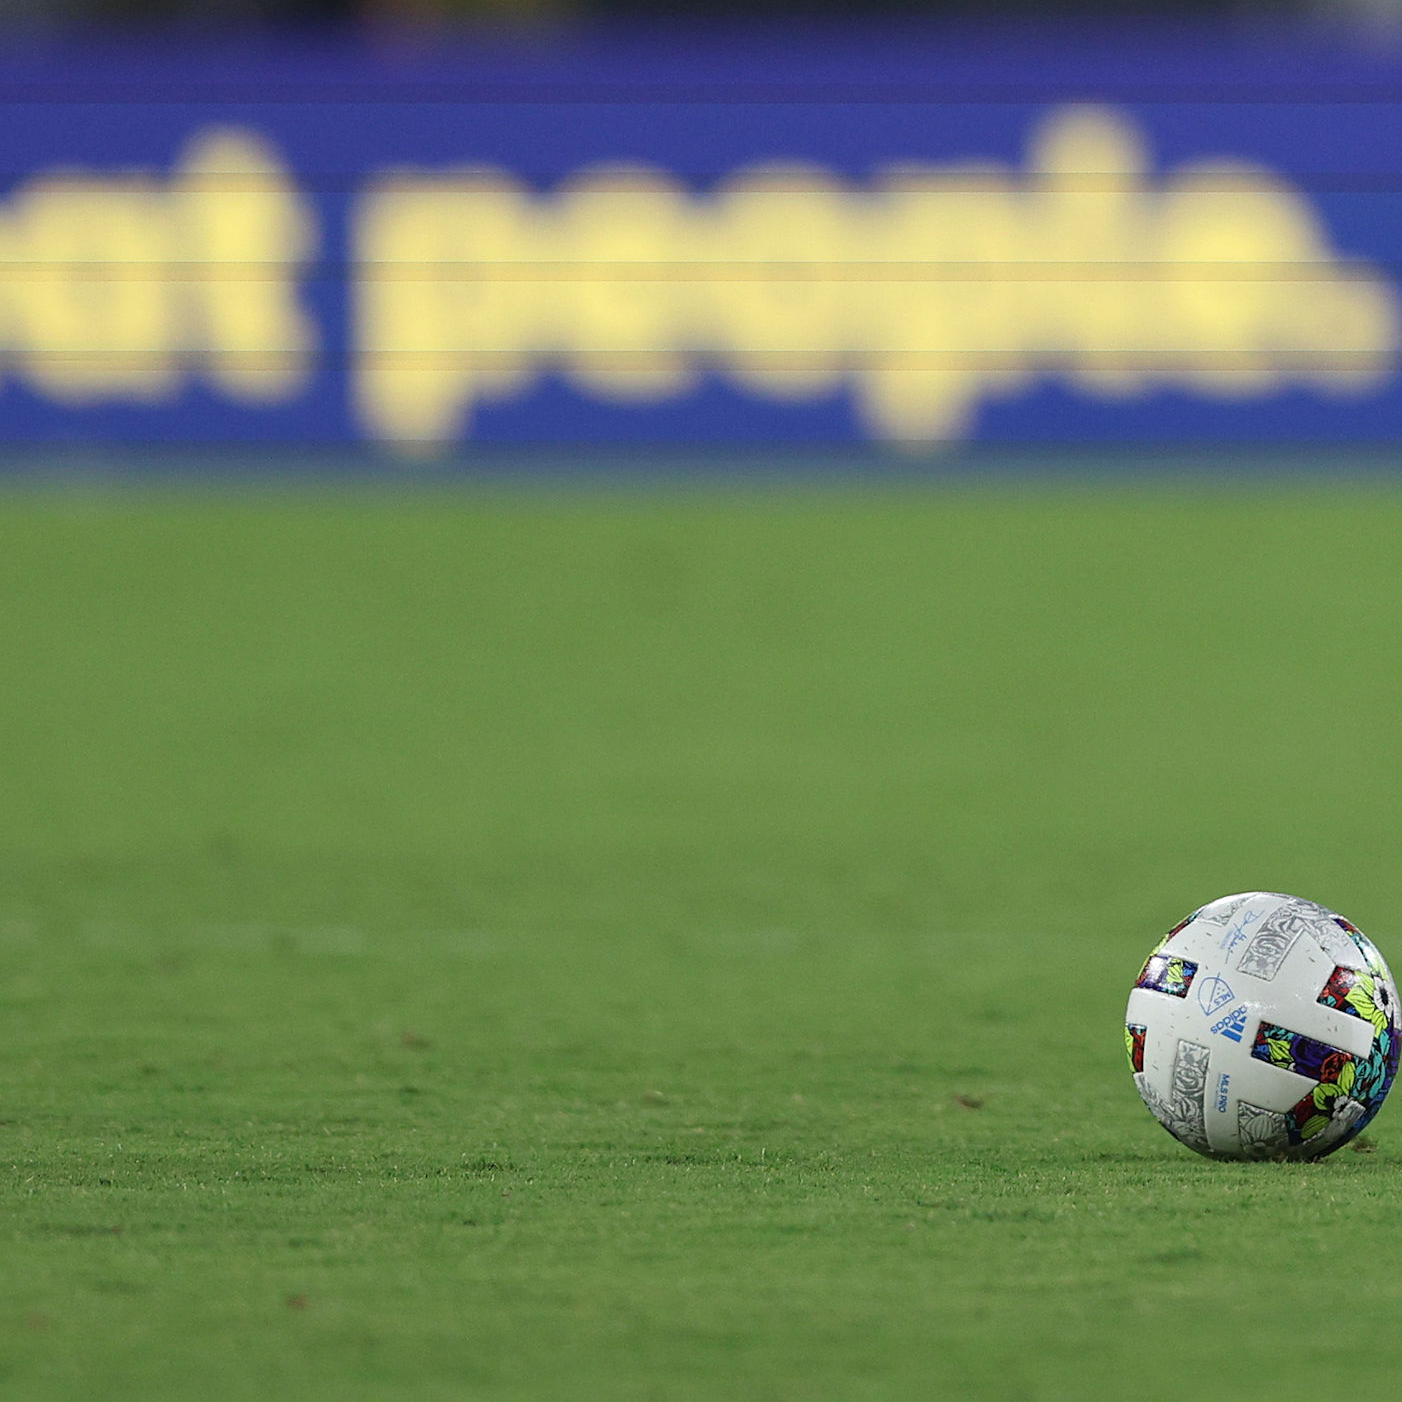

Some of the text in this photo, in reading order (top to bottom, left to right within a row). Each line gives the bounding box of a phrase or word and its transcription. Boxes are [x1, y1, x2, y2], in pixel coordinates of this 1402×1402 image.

[1210, 1005, 1248, 1035] adidas
[1218, 1073, 1230, 1113] MLS PRO
